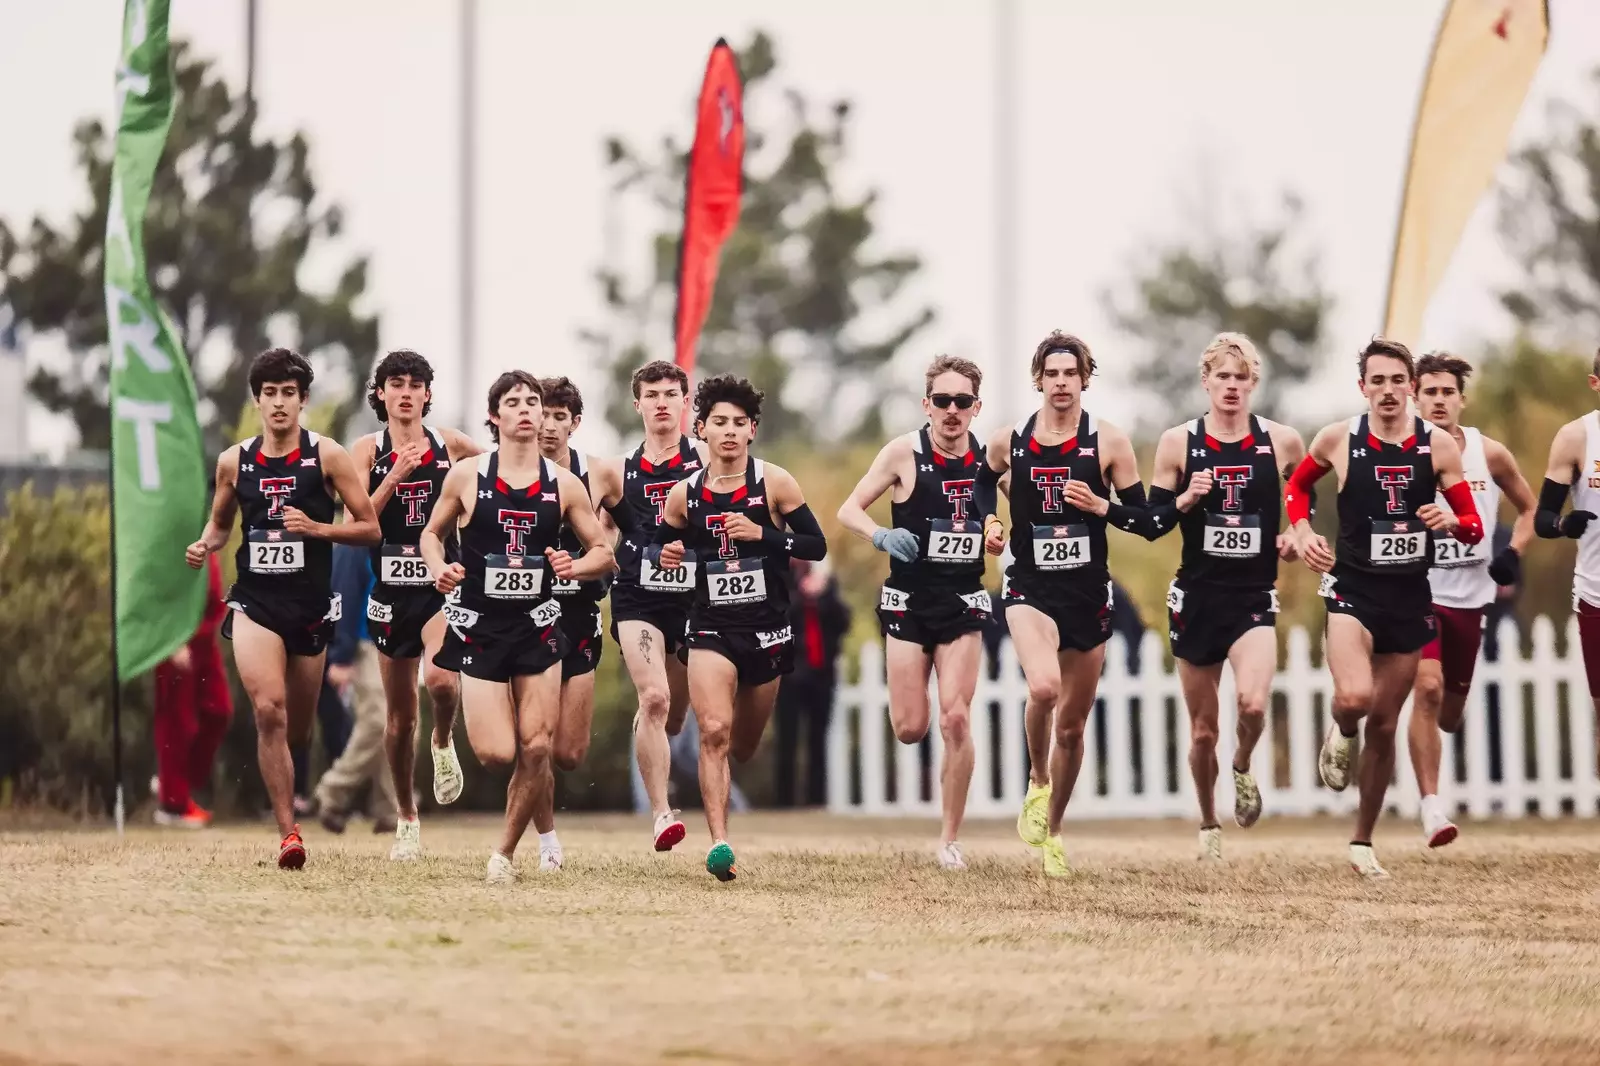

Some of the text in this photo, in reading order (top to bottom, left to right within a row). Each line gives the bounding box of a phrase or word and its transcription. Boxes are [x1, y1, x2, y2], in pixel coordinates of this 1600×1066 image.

[938, 536, 974, 555] 279
[1213, 530, 1251, 550] 289
[1381, 536, 1418, 556] 286
[257, 546, 295, 565] 278
[1042, 541, 1081, 561] 284
[1438, 542, 1475, 561] 212
[390, 560, 428, 578] 285
[649, 565, 688, 585] 280
[494, 572, 534, 591] 283
[716, 575, 756, 596] 282
[881, 590, 900, 608] 79
